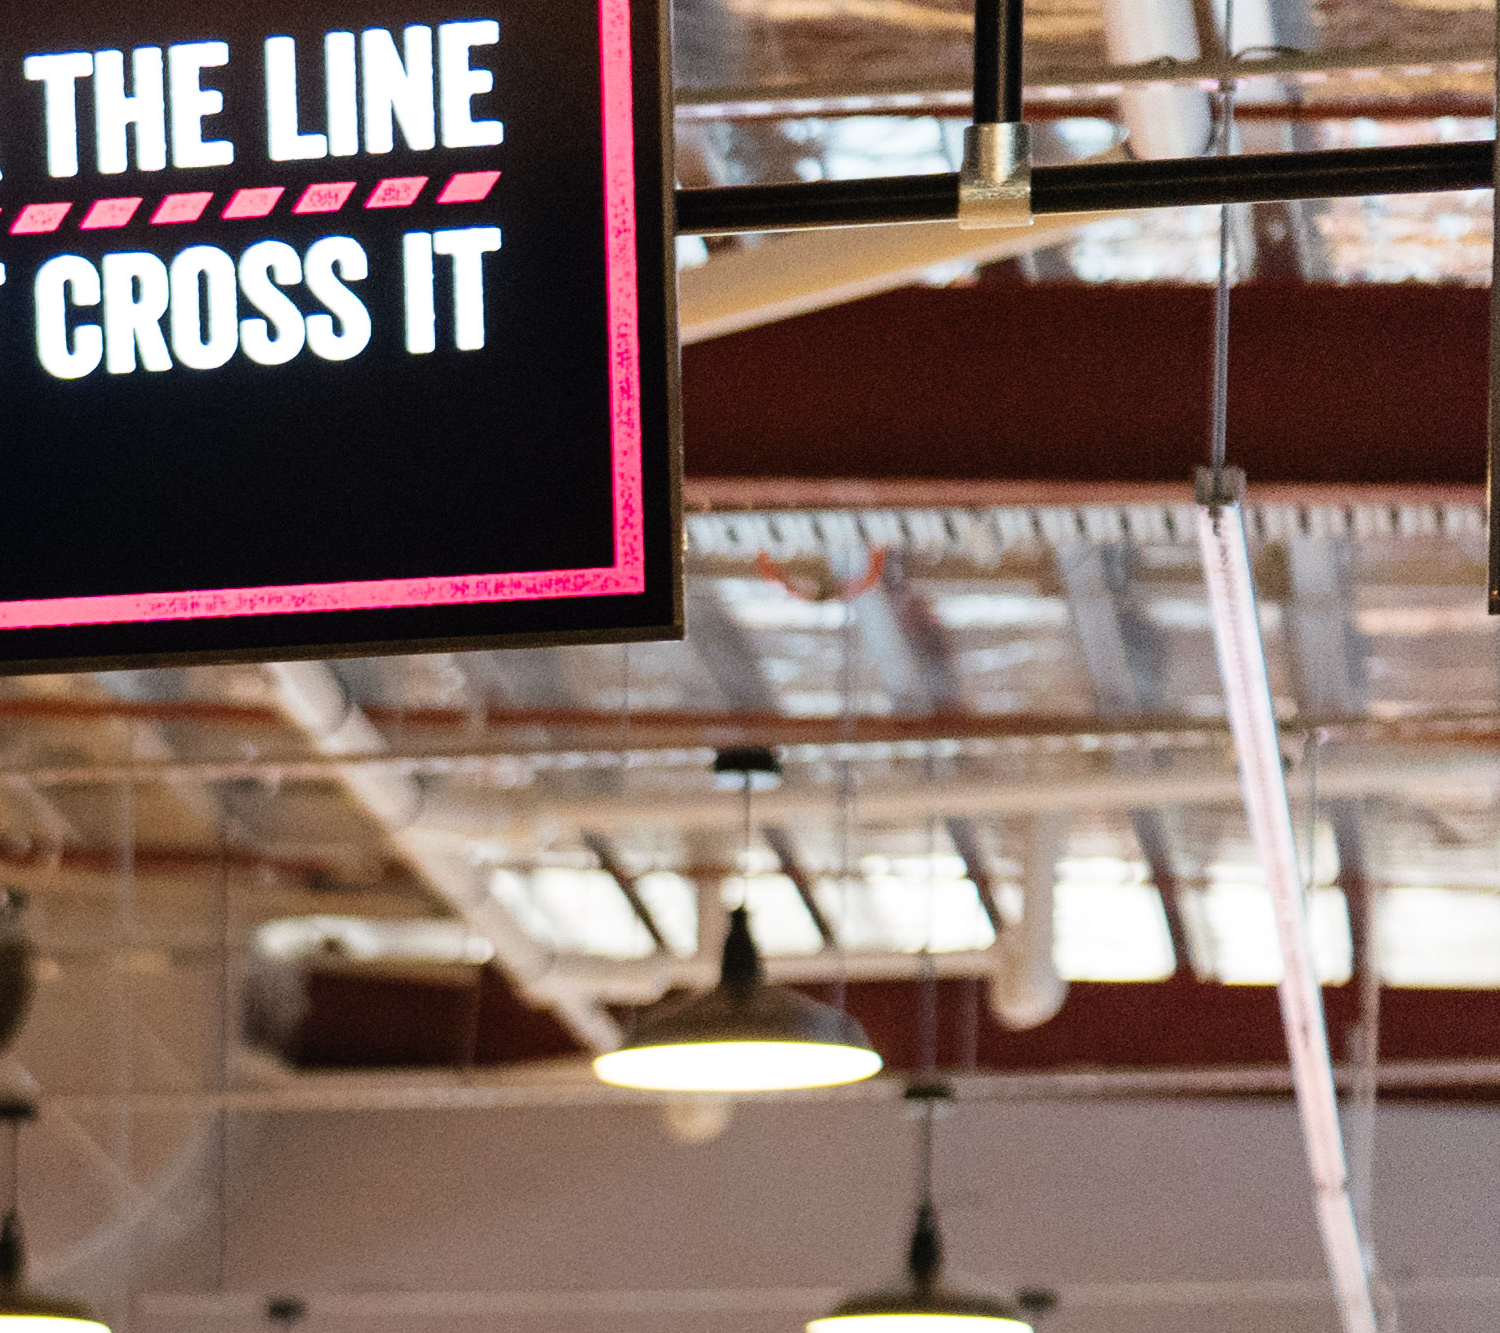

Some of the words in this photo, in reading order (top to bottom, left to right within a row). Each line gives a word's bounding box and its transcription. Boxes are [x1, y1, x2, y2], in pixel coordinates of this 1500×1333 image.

[23, 41, 235, 178] THE
[264, 19, 504, 162] LINE
[34, 235, 372, 380] CROSS
[402, 226, 502, 354] IT
